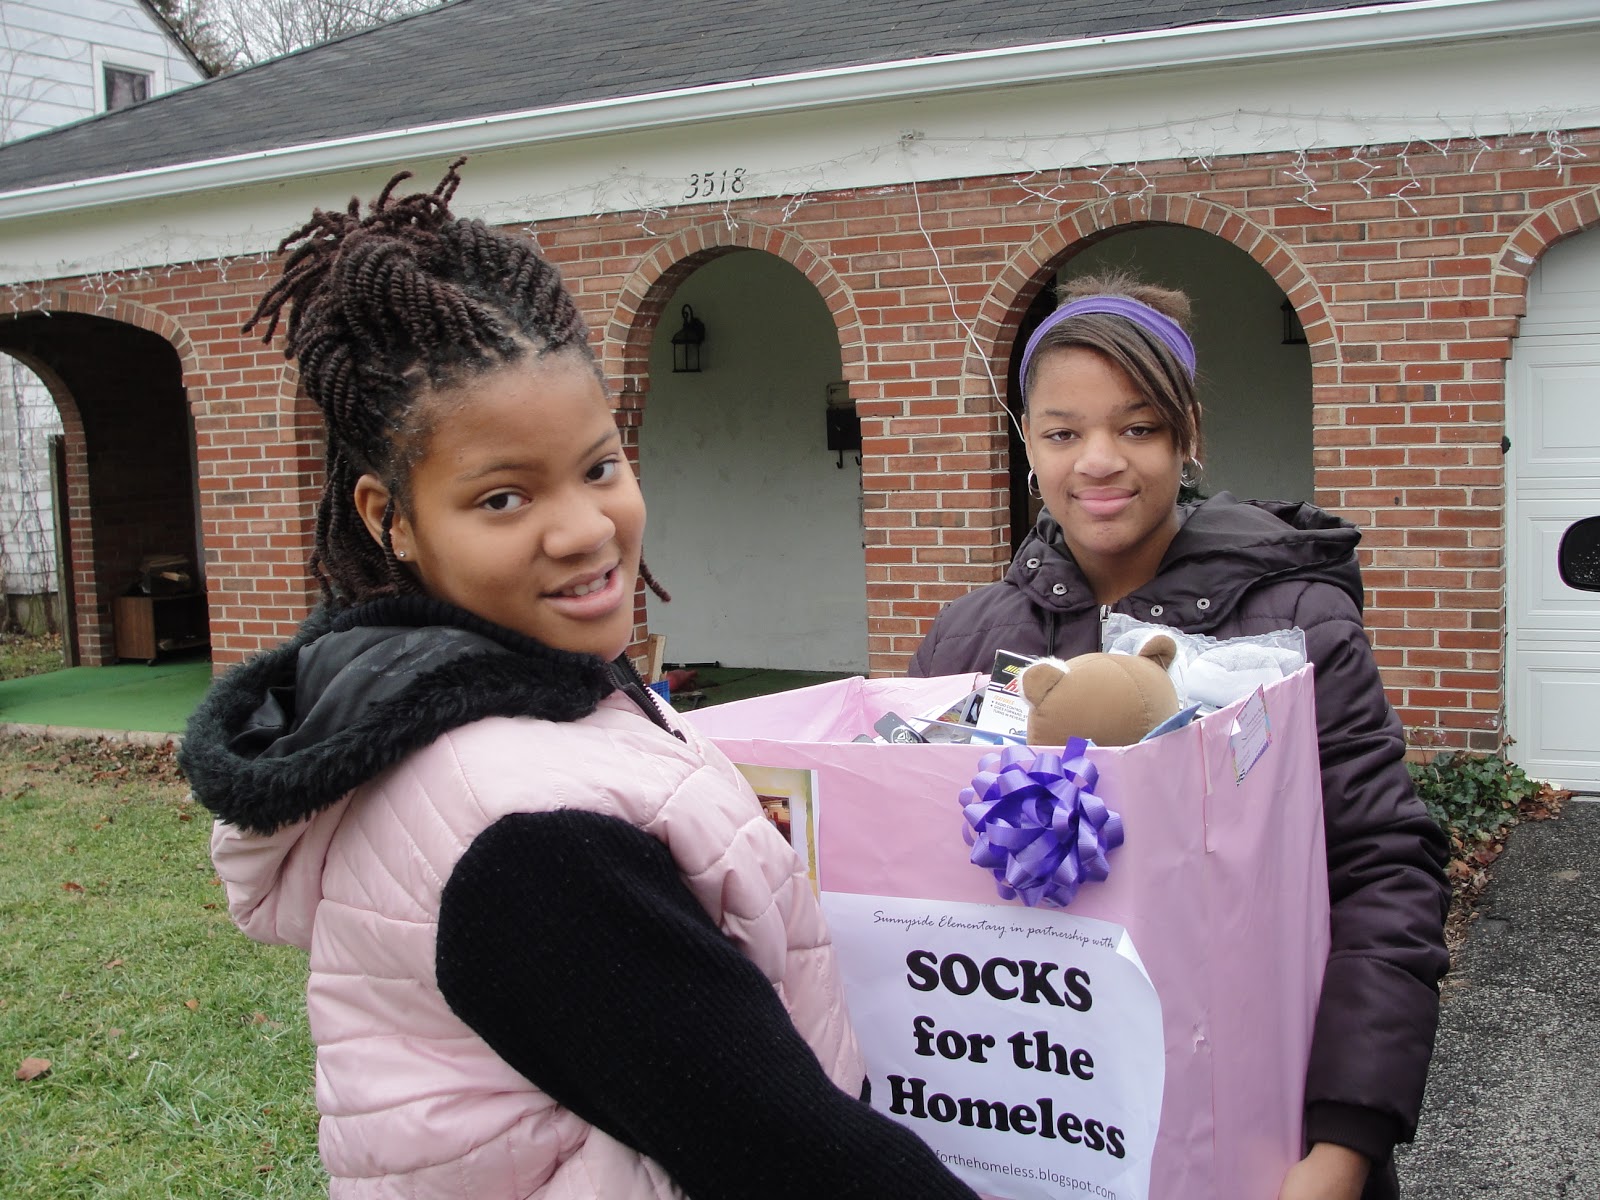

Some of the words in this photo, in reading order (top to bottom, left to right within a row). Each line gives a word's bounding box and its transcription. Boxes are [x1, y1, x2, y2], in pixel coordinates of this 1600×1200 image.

[685, 168, 746, 198] 3518
[873, 910, 935, 932] Sunnyside
[938, 915, 1006, 939] Elementary
[1010, 923, 1024, 933] in
[1026, 926, 1090, 948] partnership
[1092, 937, 1114, 949] with
[906, 950, 1093, 1012] SOCKS
[913, 1016, 996, 1064] for
[1007, 1031, 1095, 1081] the
[887, 1074, 1126, 1159] Homeless
